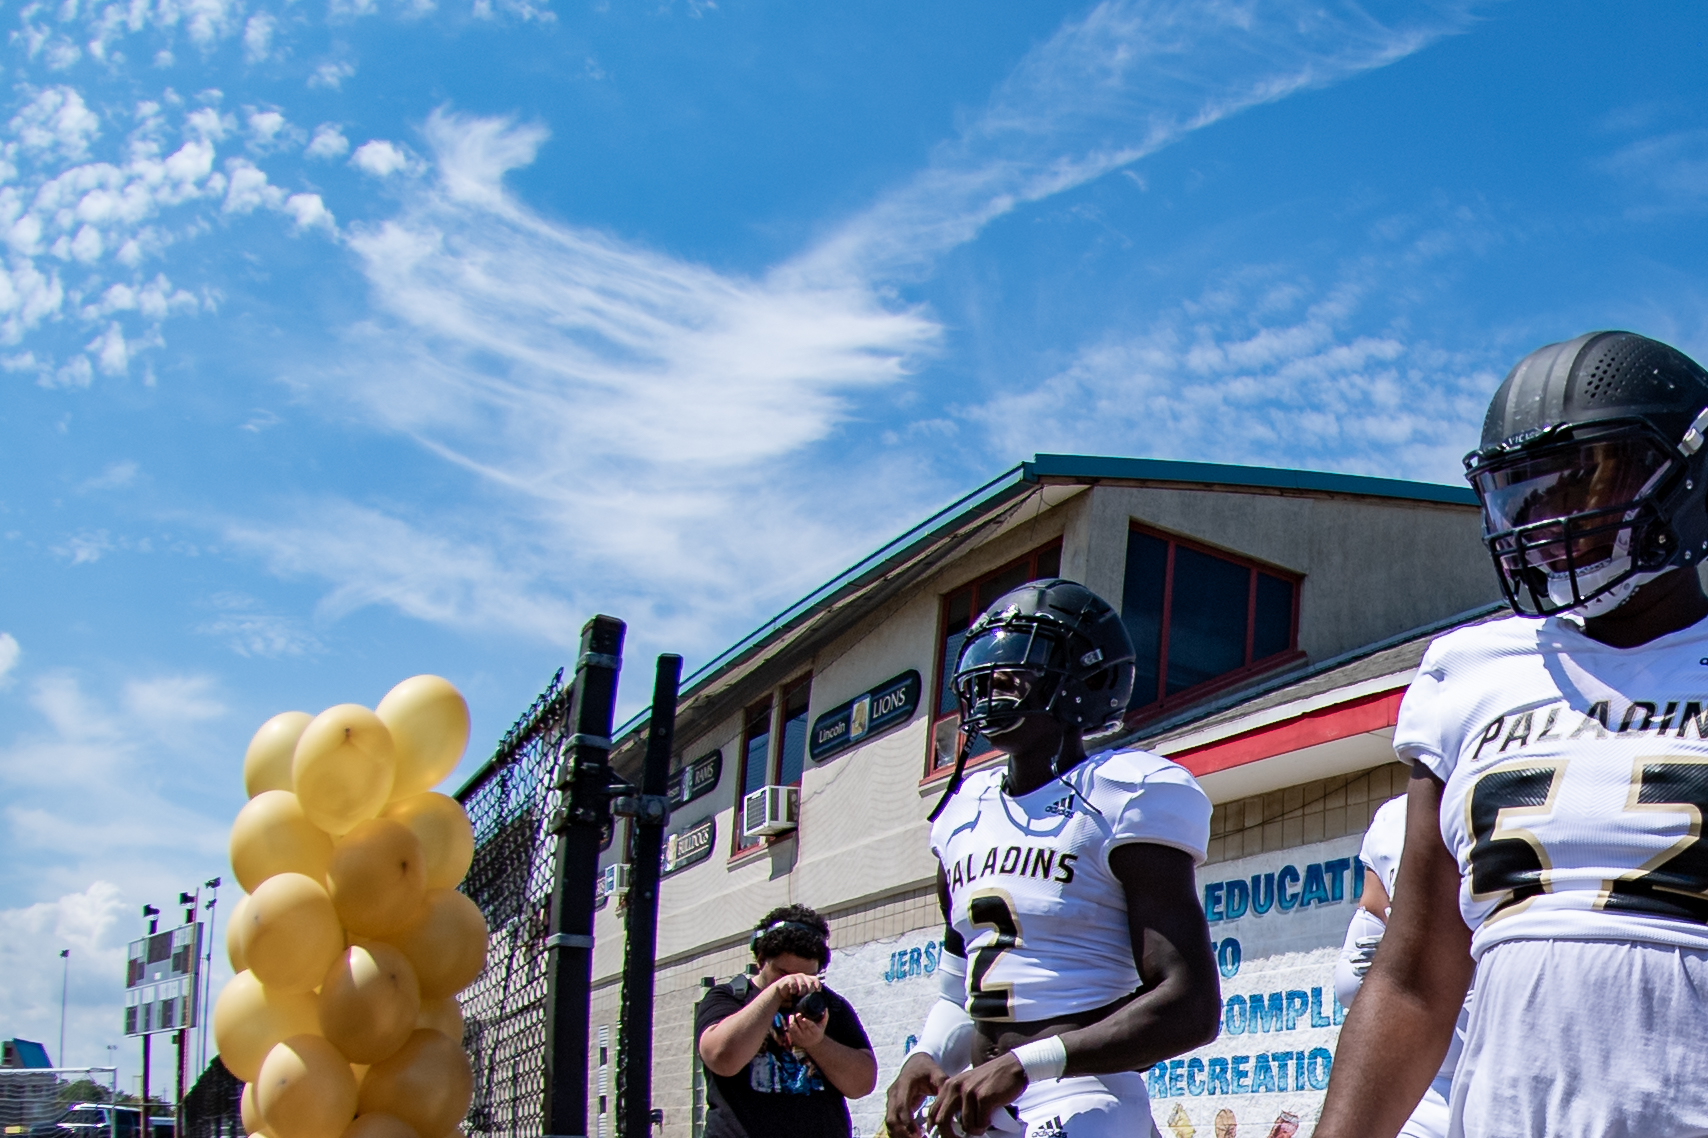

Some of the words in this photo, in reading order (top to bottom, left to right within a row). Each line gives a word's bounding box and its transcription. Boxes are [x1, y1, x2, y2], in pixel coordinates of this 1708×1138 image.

[818, 721, 846, 744] Lincoln
[872, 688, 906, 719] LIONS
[1045, 805, 1075, 819] adidas
[947, 846, 1078, 893] ALADINS
[1204, 855, 1365, 922] EDUCATI
[884, 940, 945, 983] JERS
[968, 888, 1024, 1021] 2
[1213, 937, 1241, 979] O
[1220, 986, 1346, 1036] OMPL
[1148, 1047, 1332, 1099] RECREATIO
